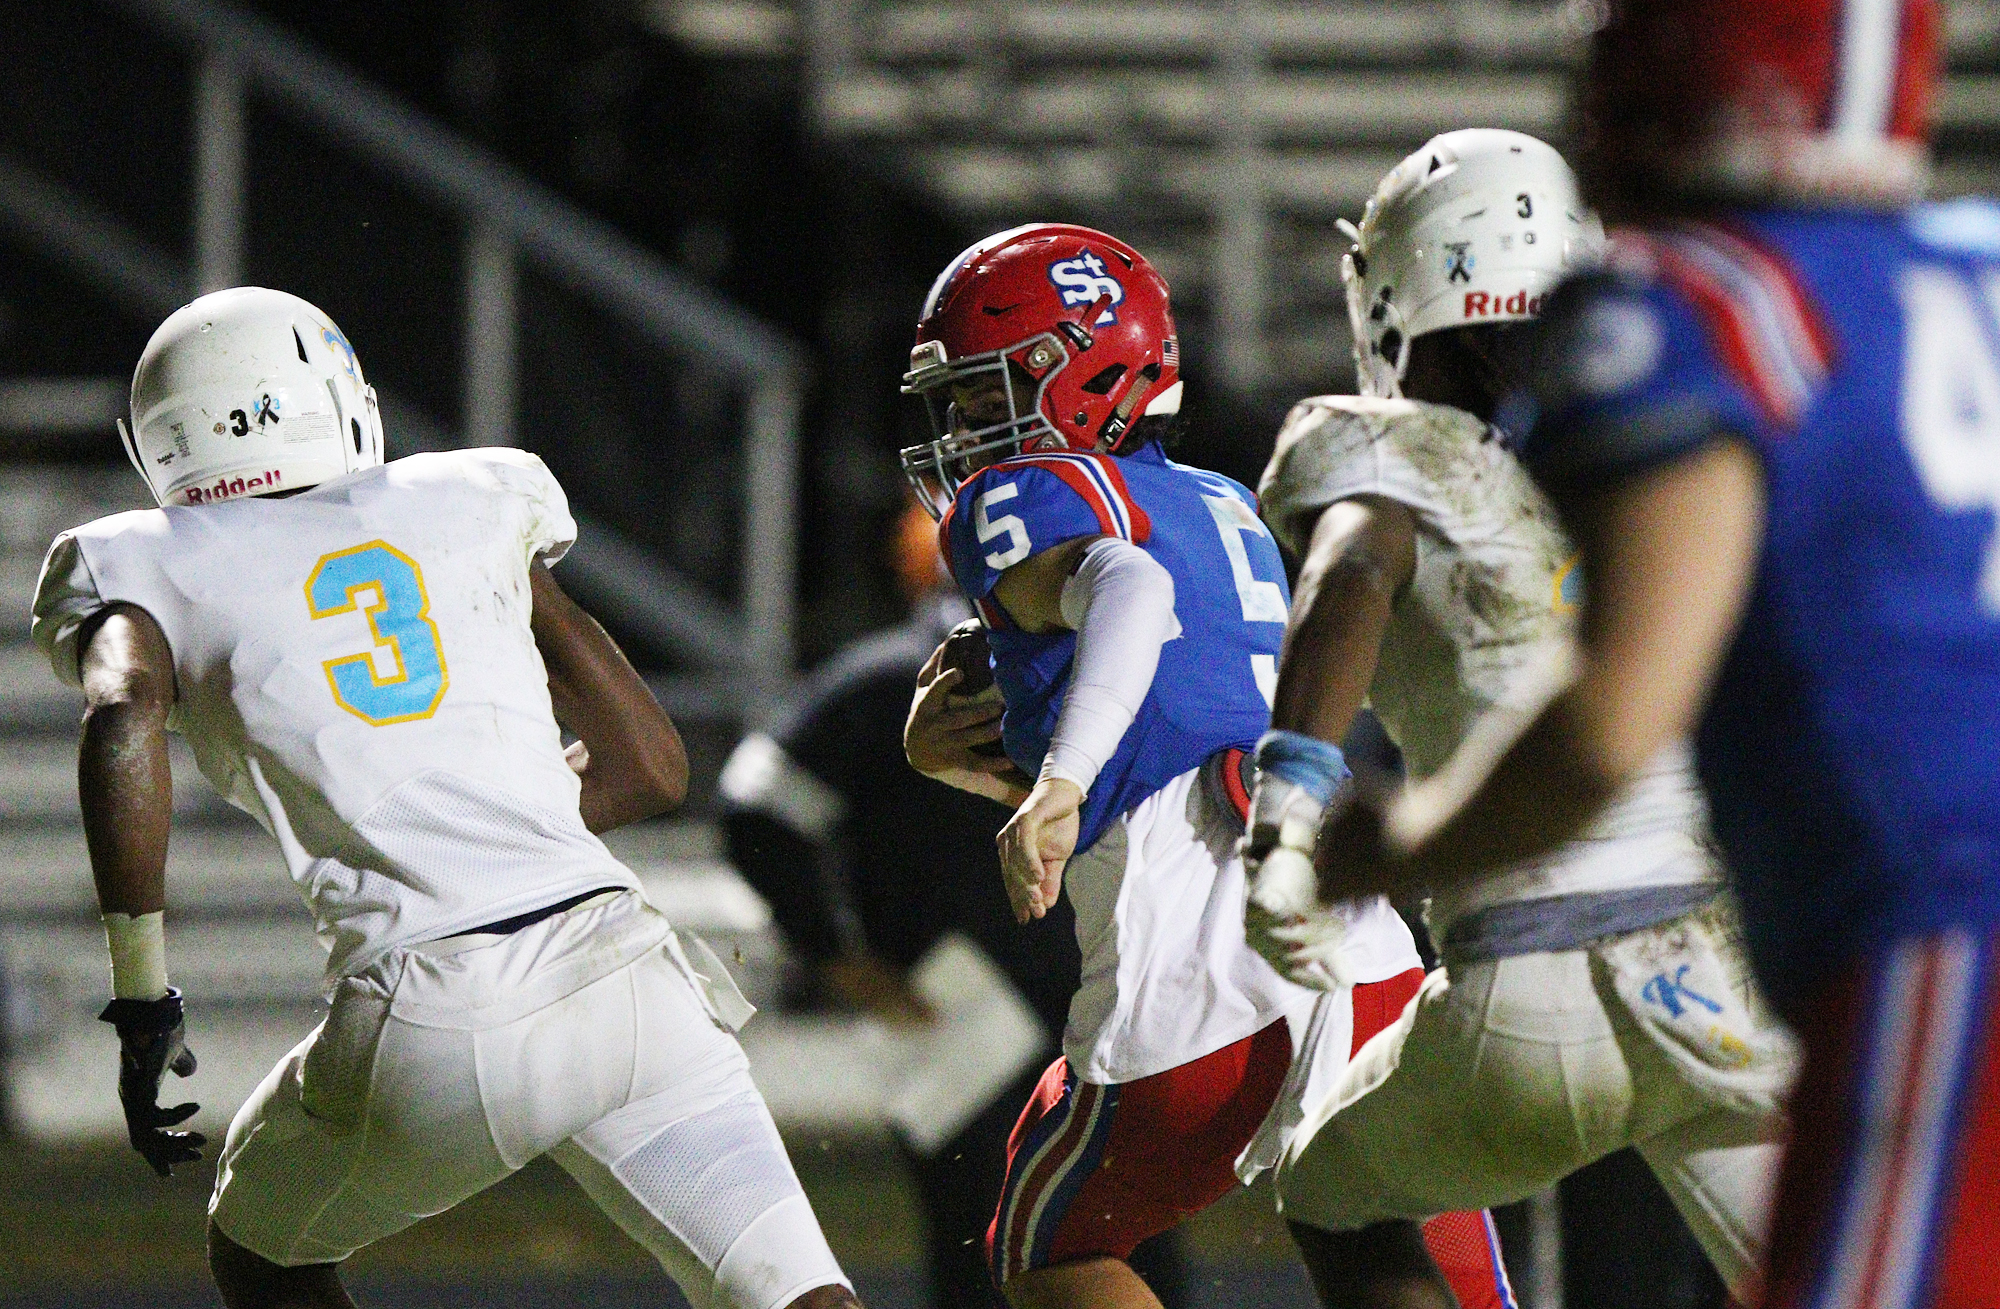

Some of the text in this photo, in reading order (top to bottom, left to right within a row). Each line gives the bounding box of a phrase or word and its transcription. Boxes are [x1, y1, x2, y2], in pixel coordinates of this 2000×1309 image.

[1515, 192, 1534, 219] 3
[229, 408, 249, 438] 3
[185, 469, 282, 504] Riddell
[974, 481, 1032, 571] 5
[303, 538, 450, 728] 3
[1200, 493, 1289, 712] 5
